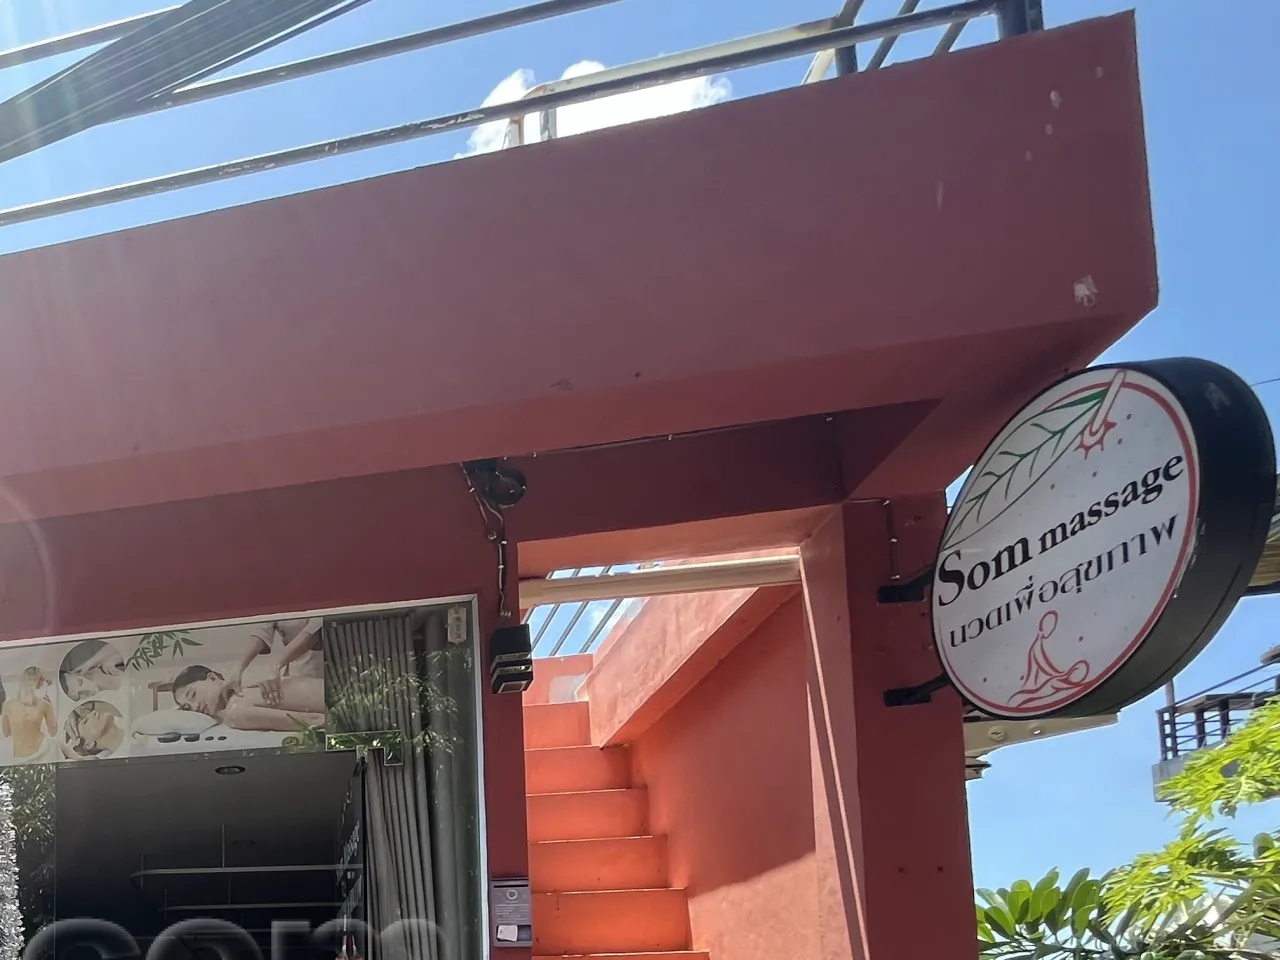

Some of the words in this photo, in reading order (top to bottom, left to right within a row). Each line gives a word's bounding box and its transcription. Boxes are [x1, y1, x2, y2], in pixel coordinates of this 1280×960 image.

[938, 537, 1034, 606] Som
[1037, 455, 1184, 555] massage
[950, 515, 1178, 648] นวดเพื่อสุขภาพ
